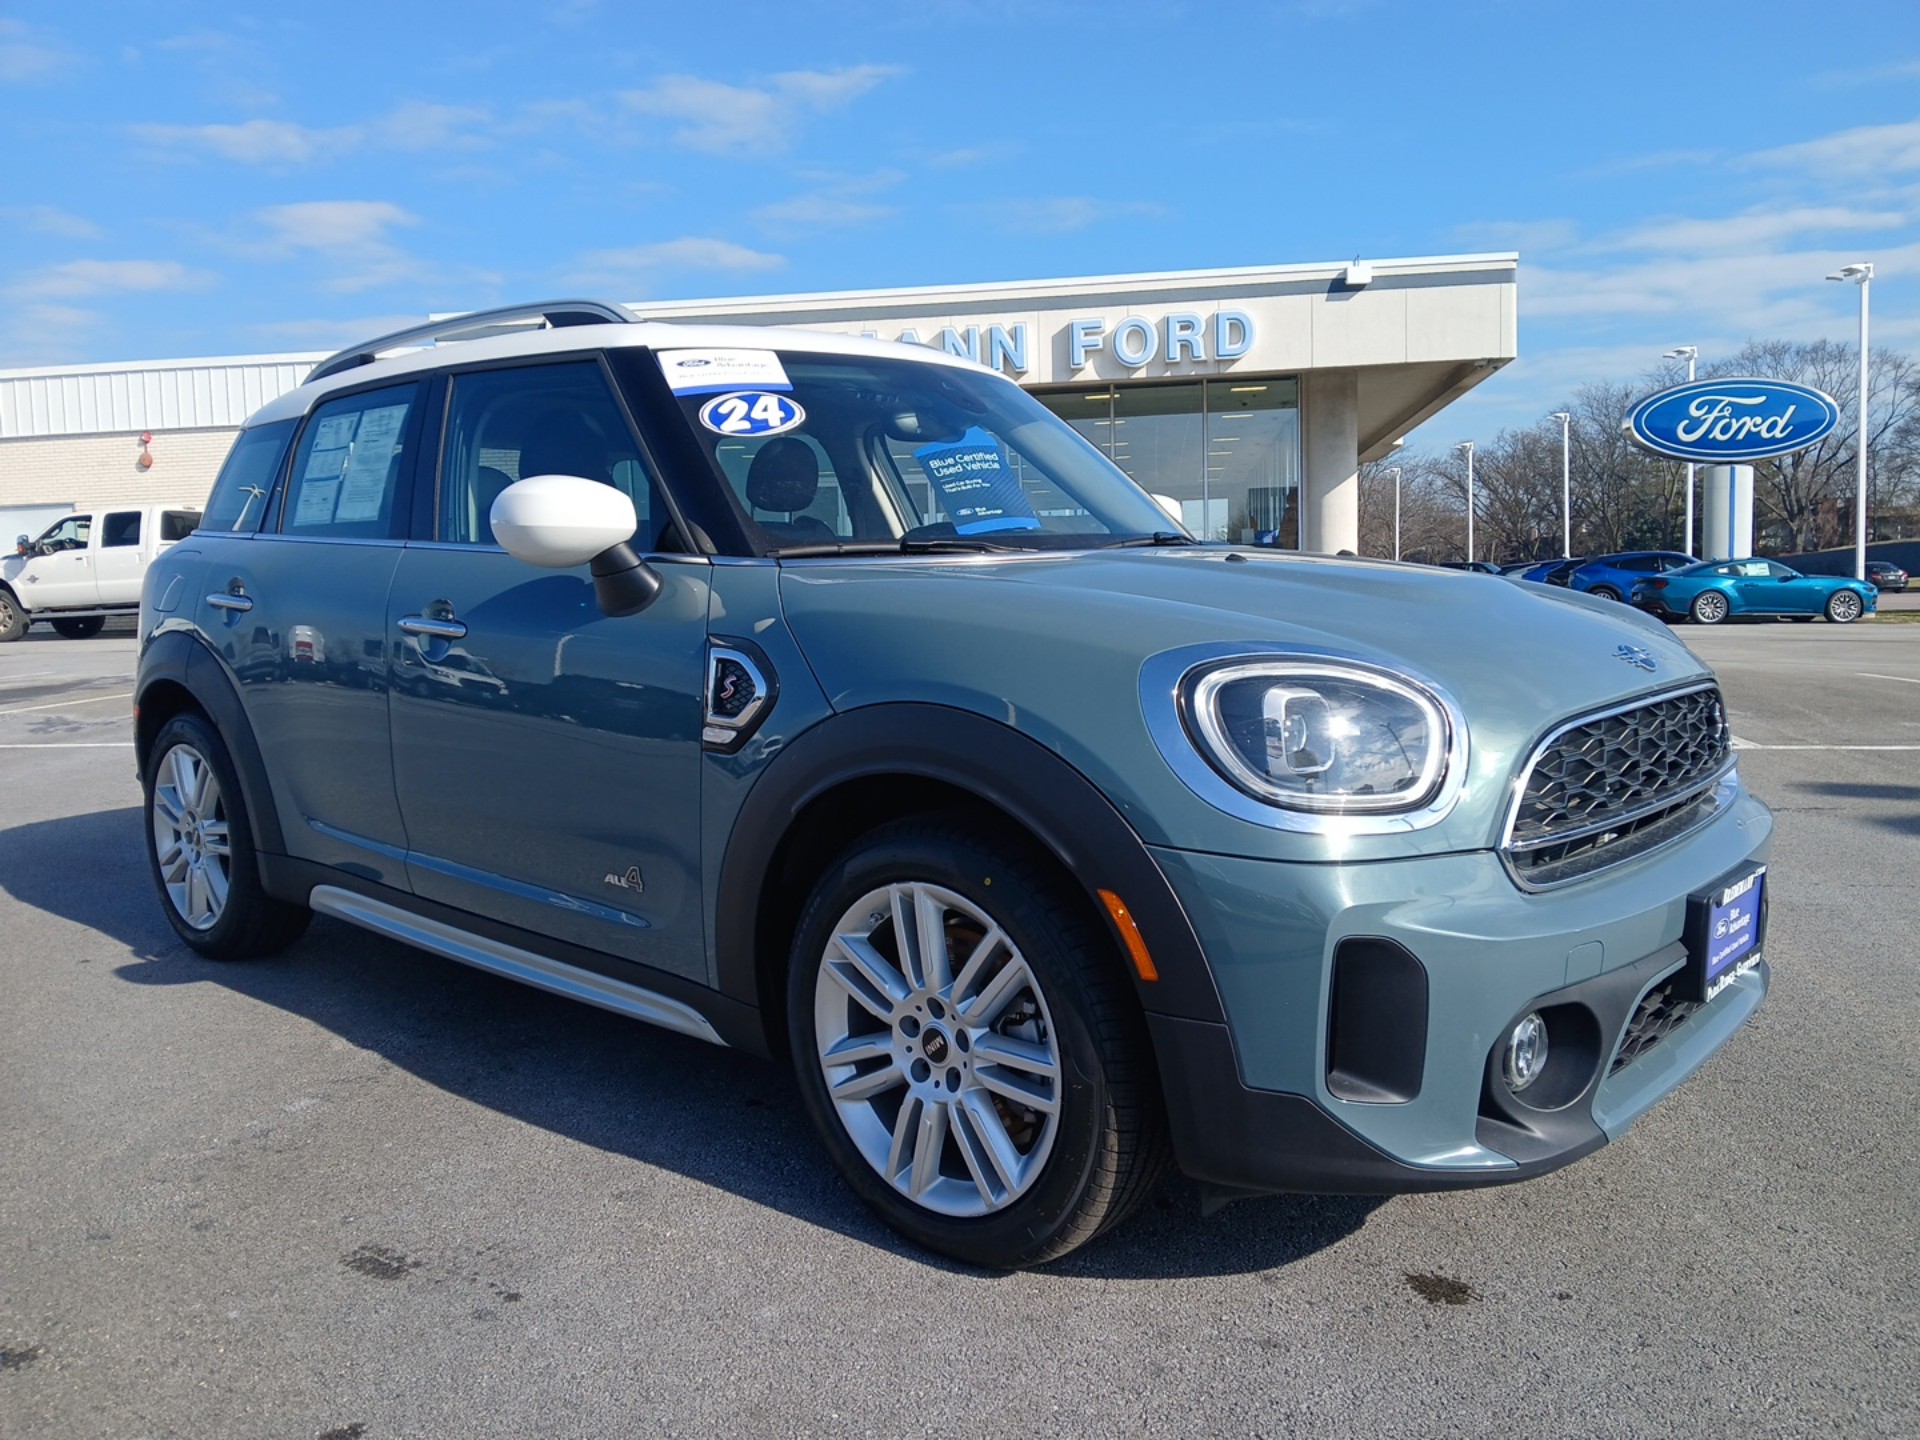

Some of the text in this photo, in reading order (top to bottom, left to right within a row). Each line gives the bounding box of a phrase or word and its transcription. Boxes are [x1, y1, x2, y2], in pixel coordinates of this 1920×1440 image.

[1070, 309, 1256, 368] FORD
[717, 396, 785, 432] 24
[1676, 395, 1797, 443] Ford
[929, 452, 999, 469] Blue Certified
[934, 461, 1000, 476] Used Vehicle
[925, 1035, 944, 1055] MINI
